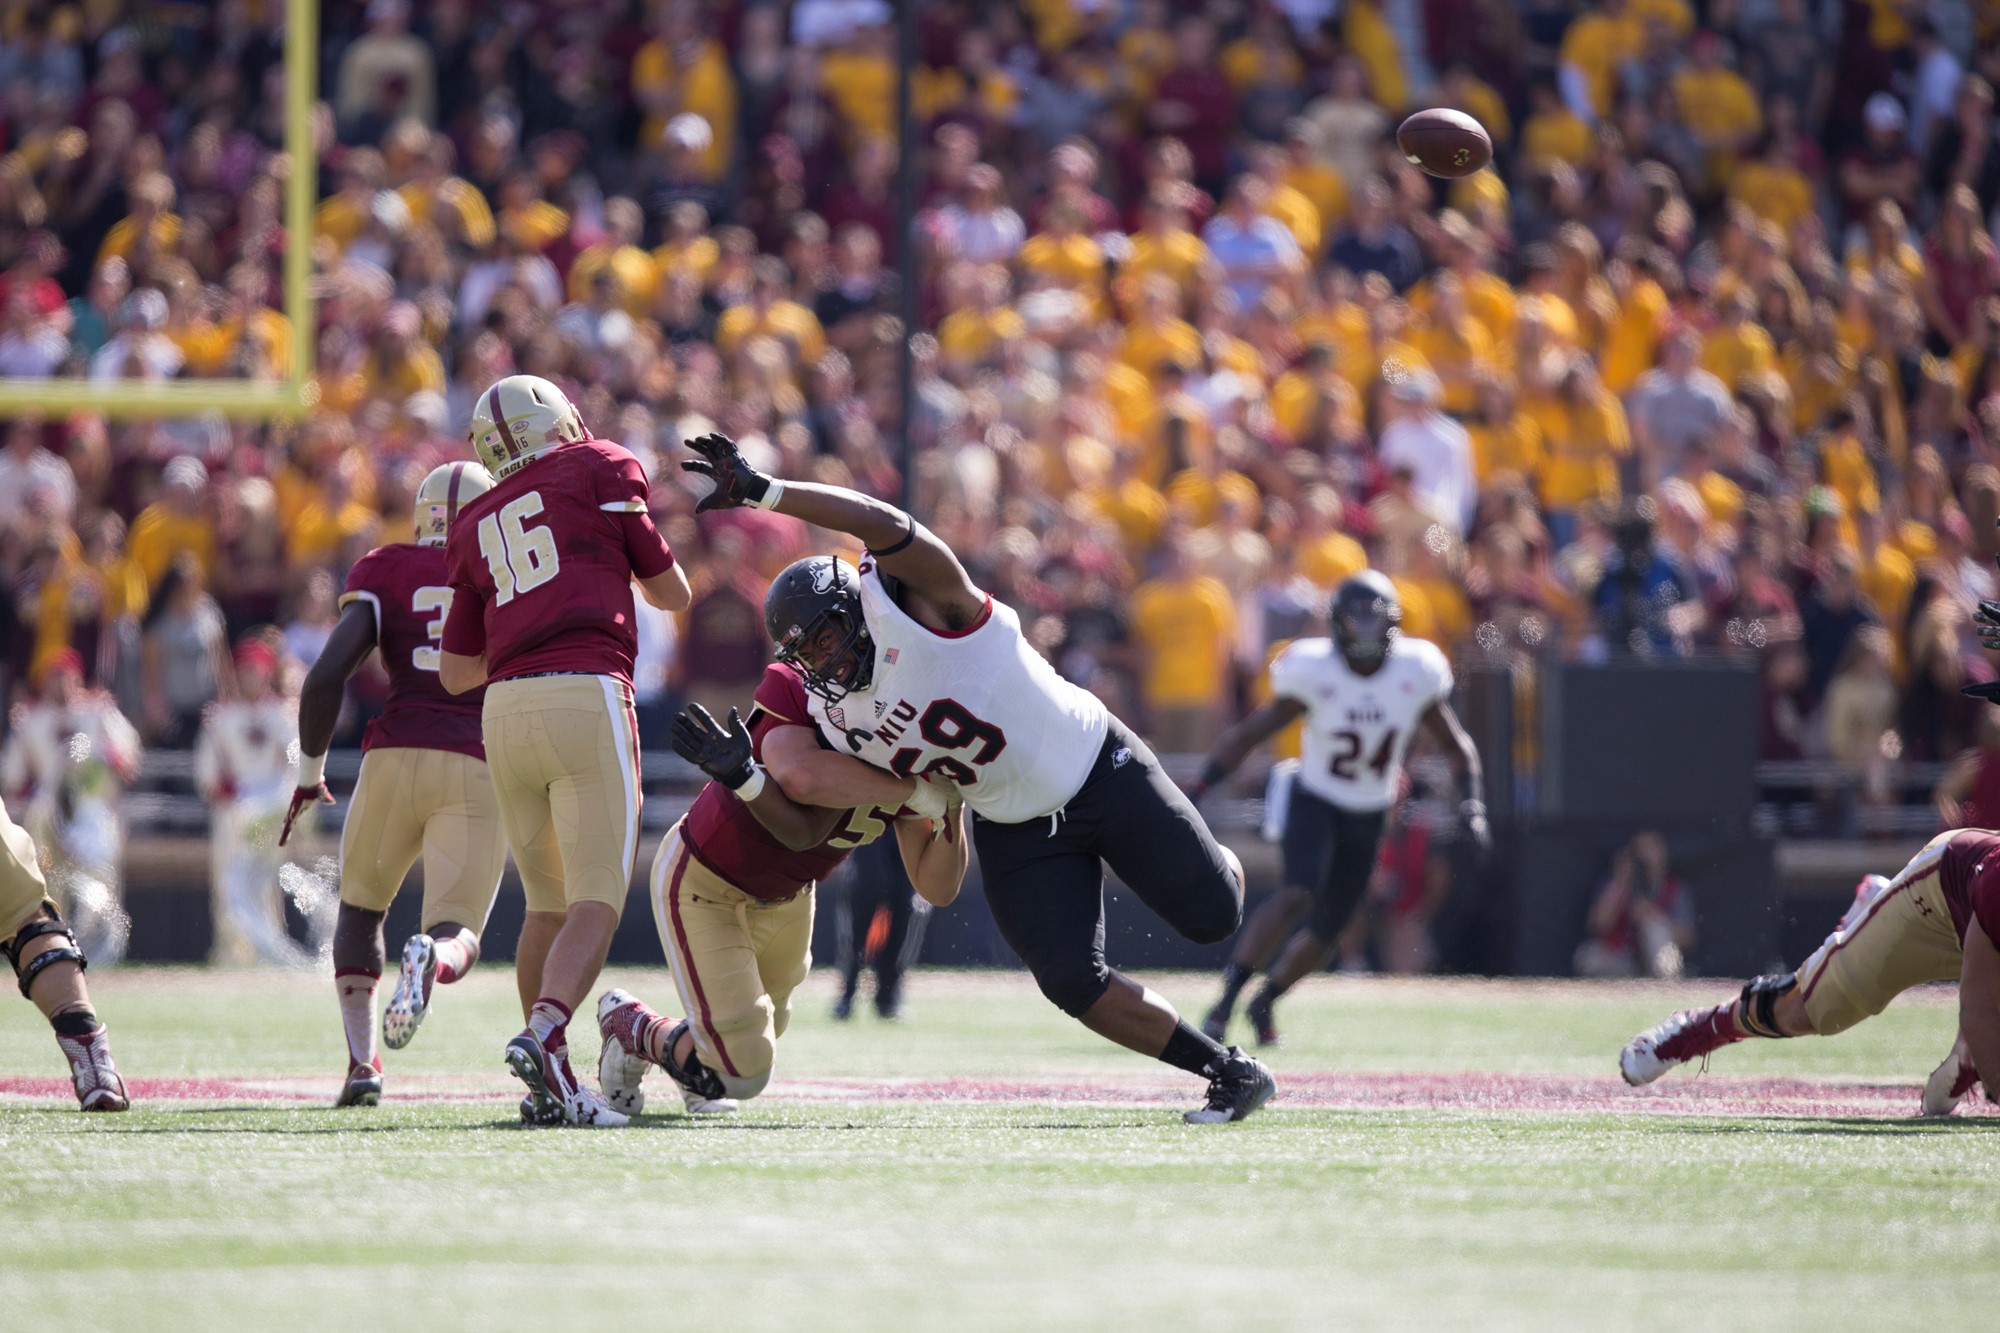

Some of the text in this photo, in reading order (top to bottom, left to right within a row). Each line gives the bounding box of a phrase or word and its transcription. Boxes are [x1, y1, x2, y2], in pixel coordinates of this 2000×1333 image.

[515, 436, 529, 450] 16
[499, 454, 536, 478] EAGLES
[478, 491, 559, 608] 16
[873, 698, 918, 747] NIU
